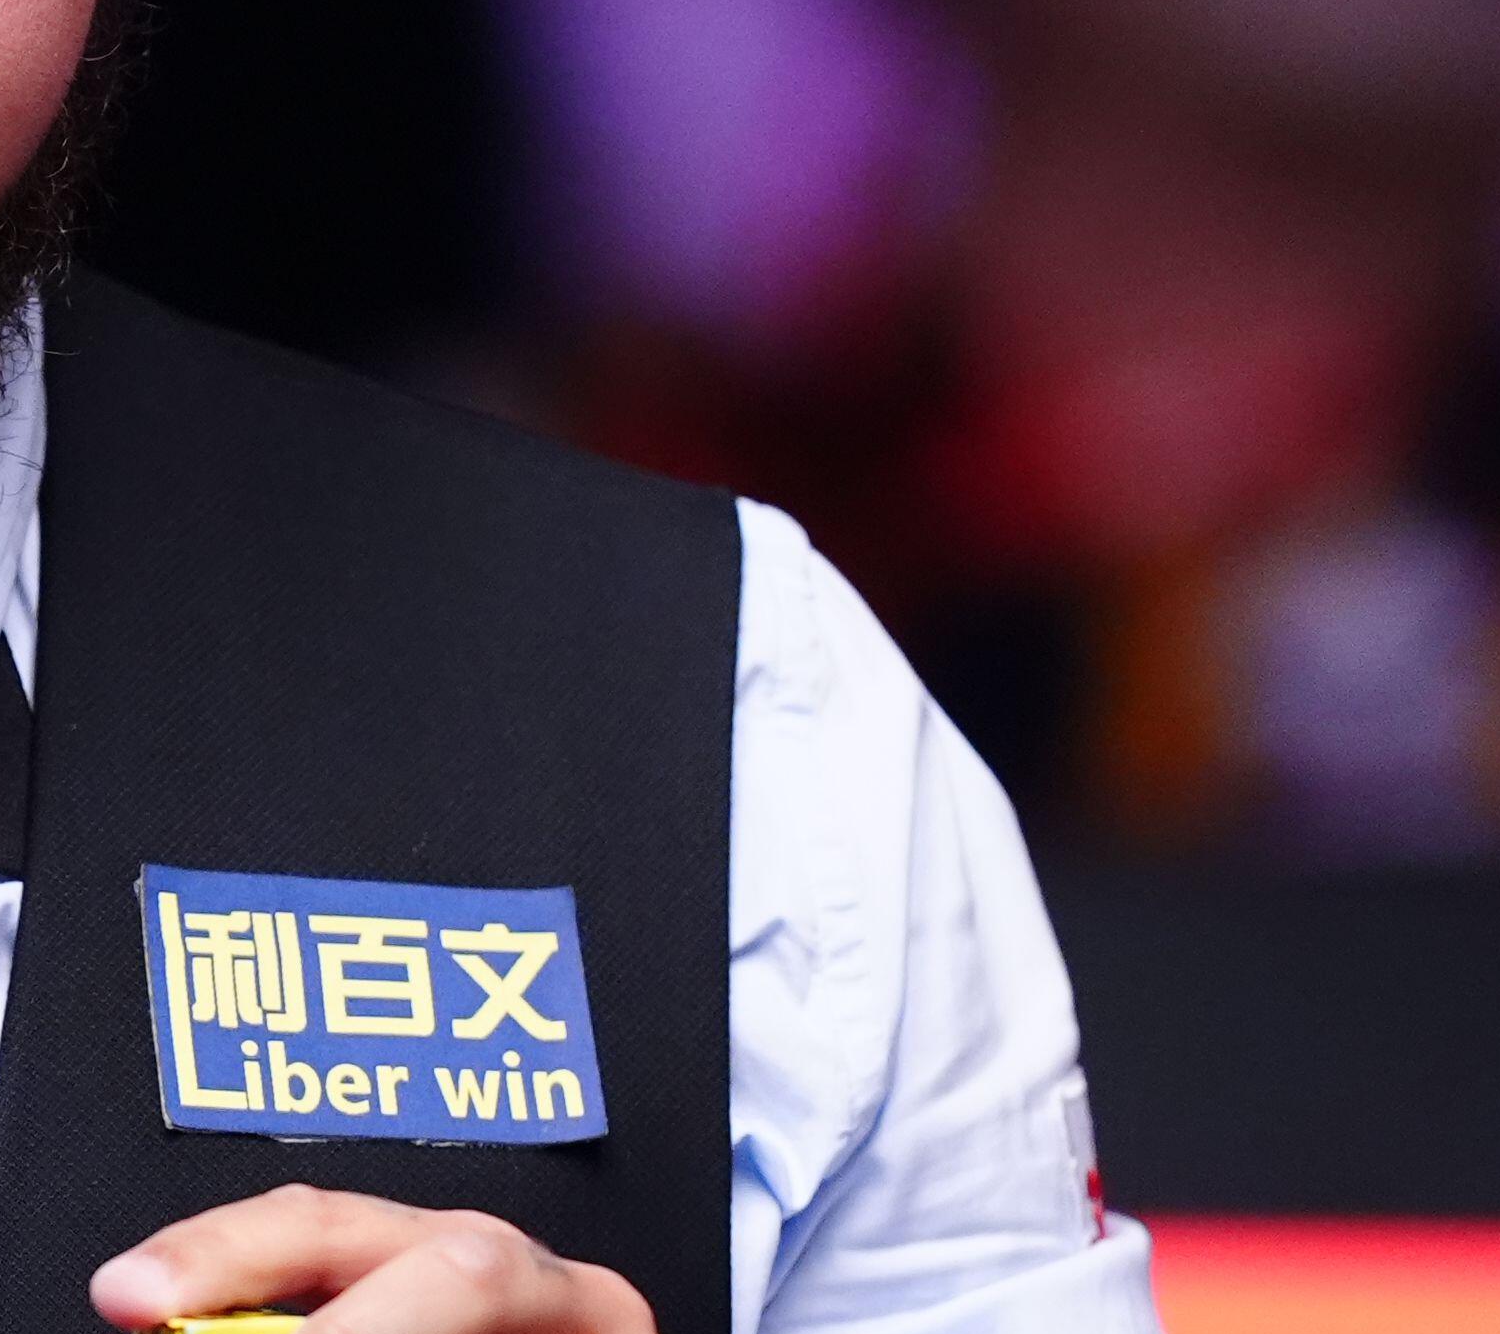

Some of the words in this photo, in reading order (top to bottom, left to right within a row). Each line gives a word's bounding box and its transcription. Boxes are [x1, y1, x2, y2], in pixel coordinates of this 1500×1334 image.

[184, 910, 568, 1042] 利百文
[434, 1050, 585, 1122] win
